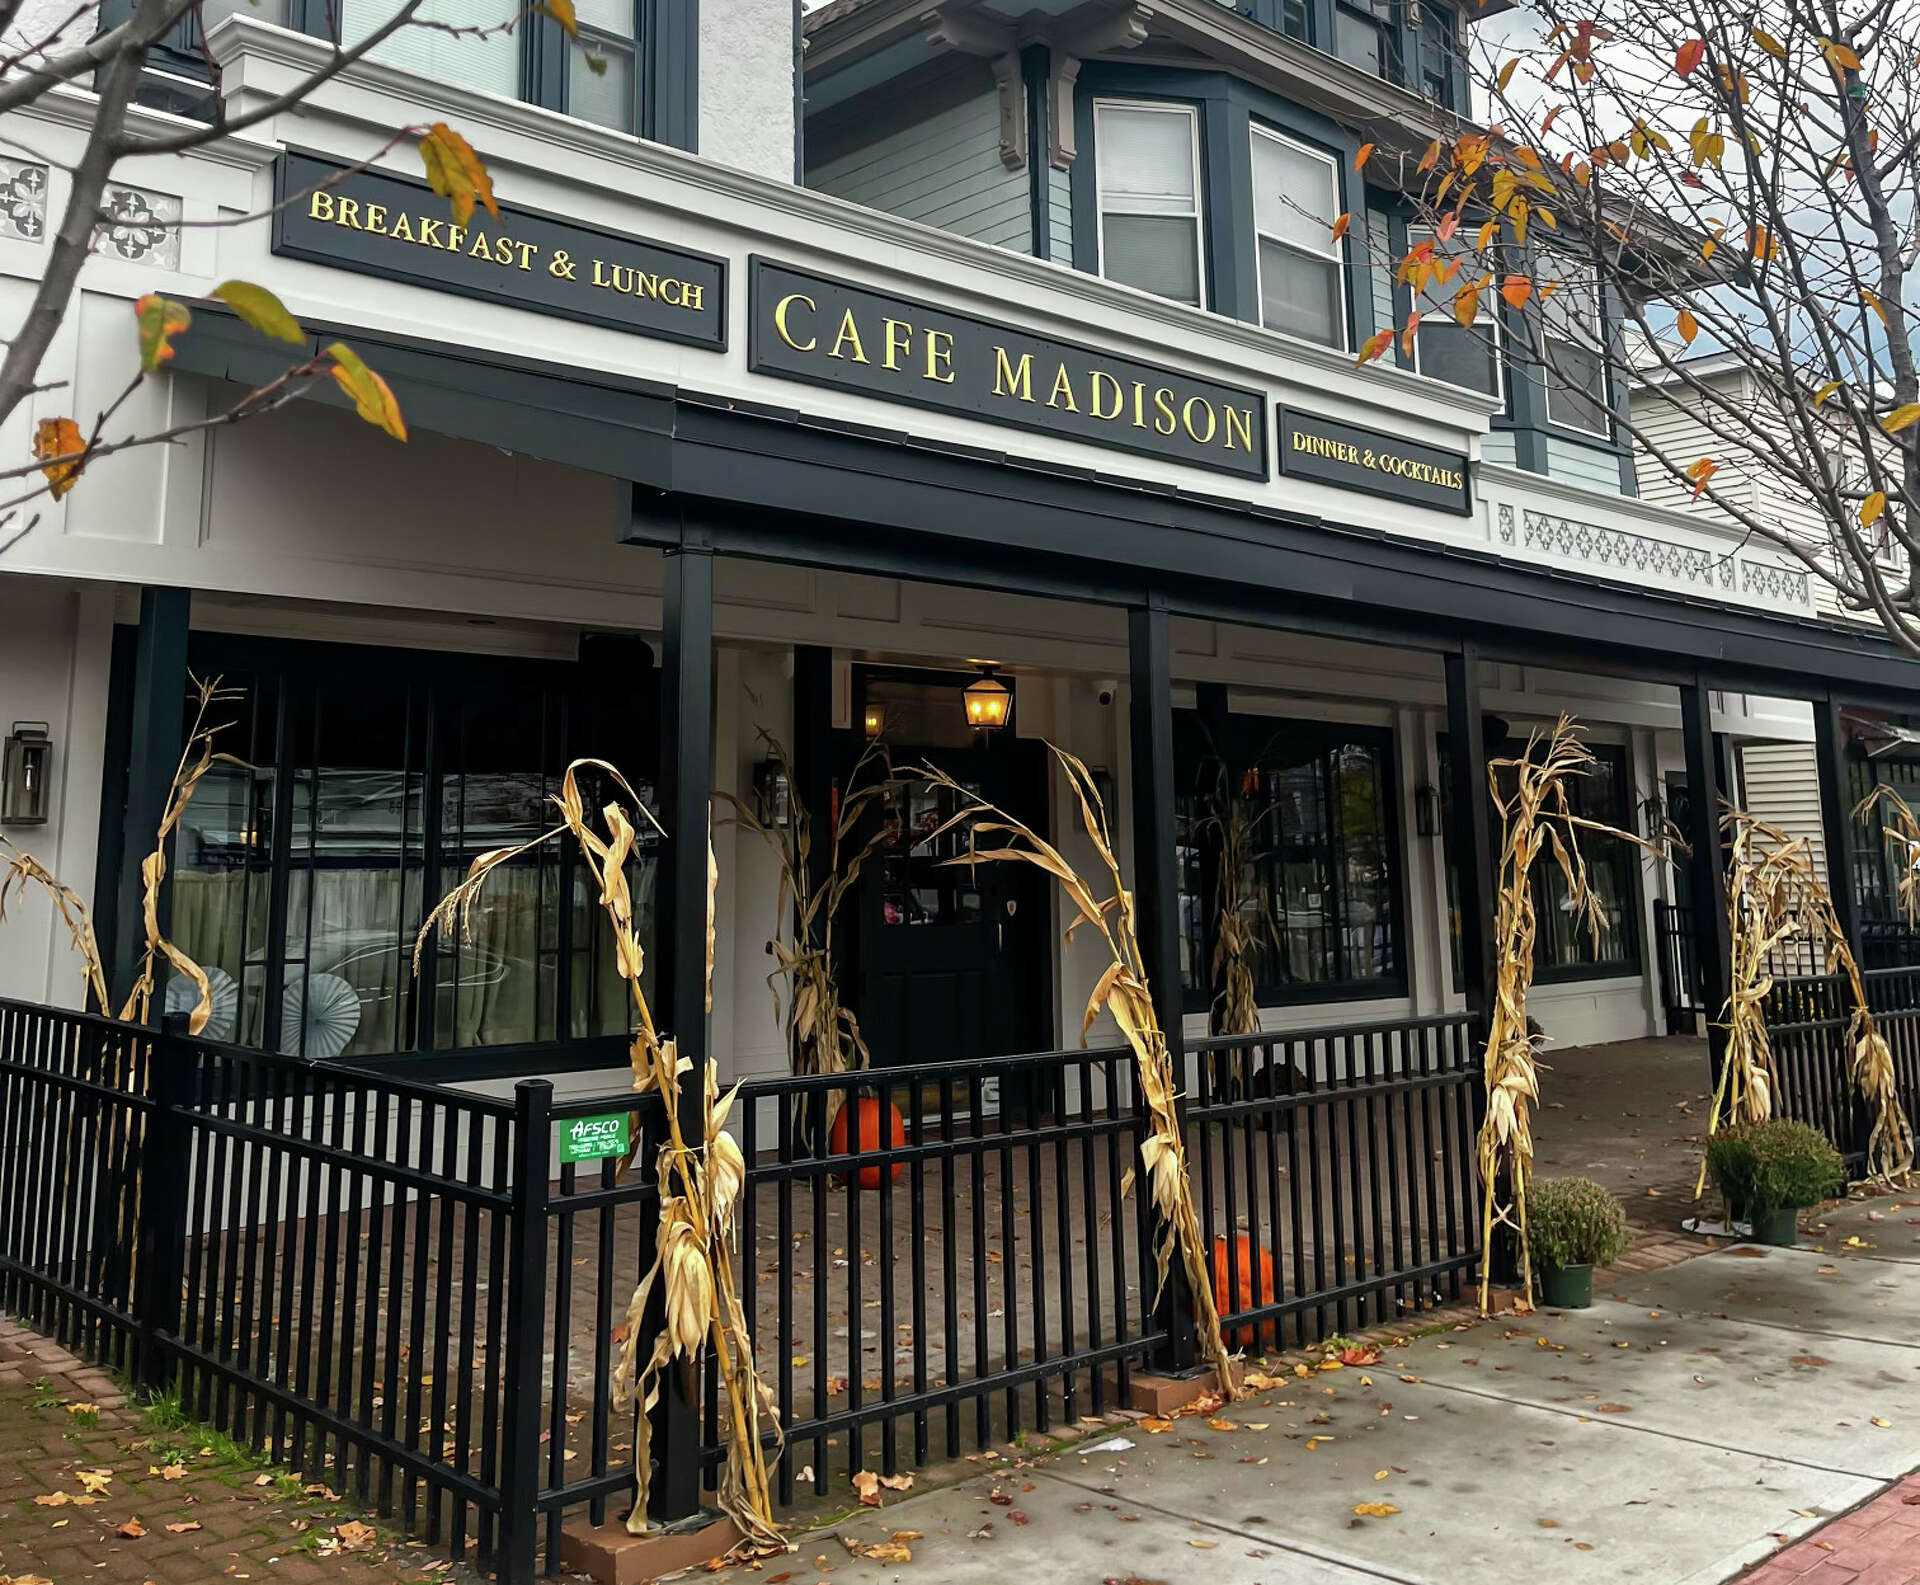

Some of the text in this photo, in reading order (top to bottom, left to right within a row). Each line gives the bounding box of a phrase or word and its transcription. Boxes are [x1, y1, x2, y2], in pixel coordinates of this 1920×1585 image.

[308, 190, 705, 311] BREAKFAST & LUNCH
[774, 293, 1254, 454] CAFE MADISON
[1291, 431, 1464, 490] DINNER & COCKTAILS
[570, 1120, 620, 1140] AFSCO
